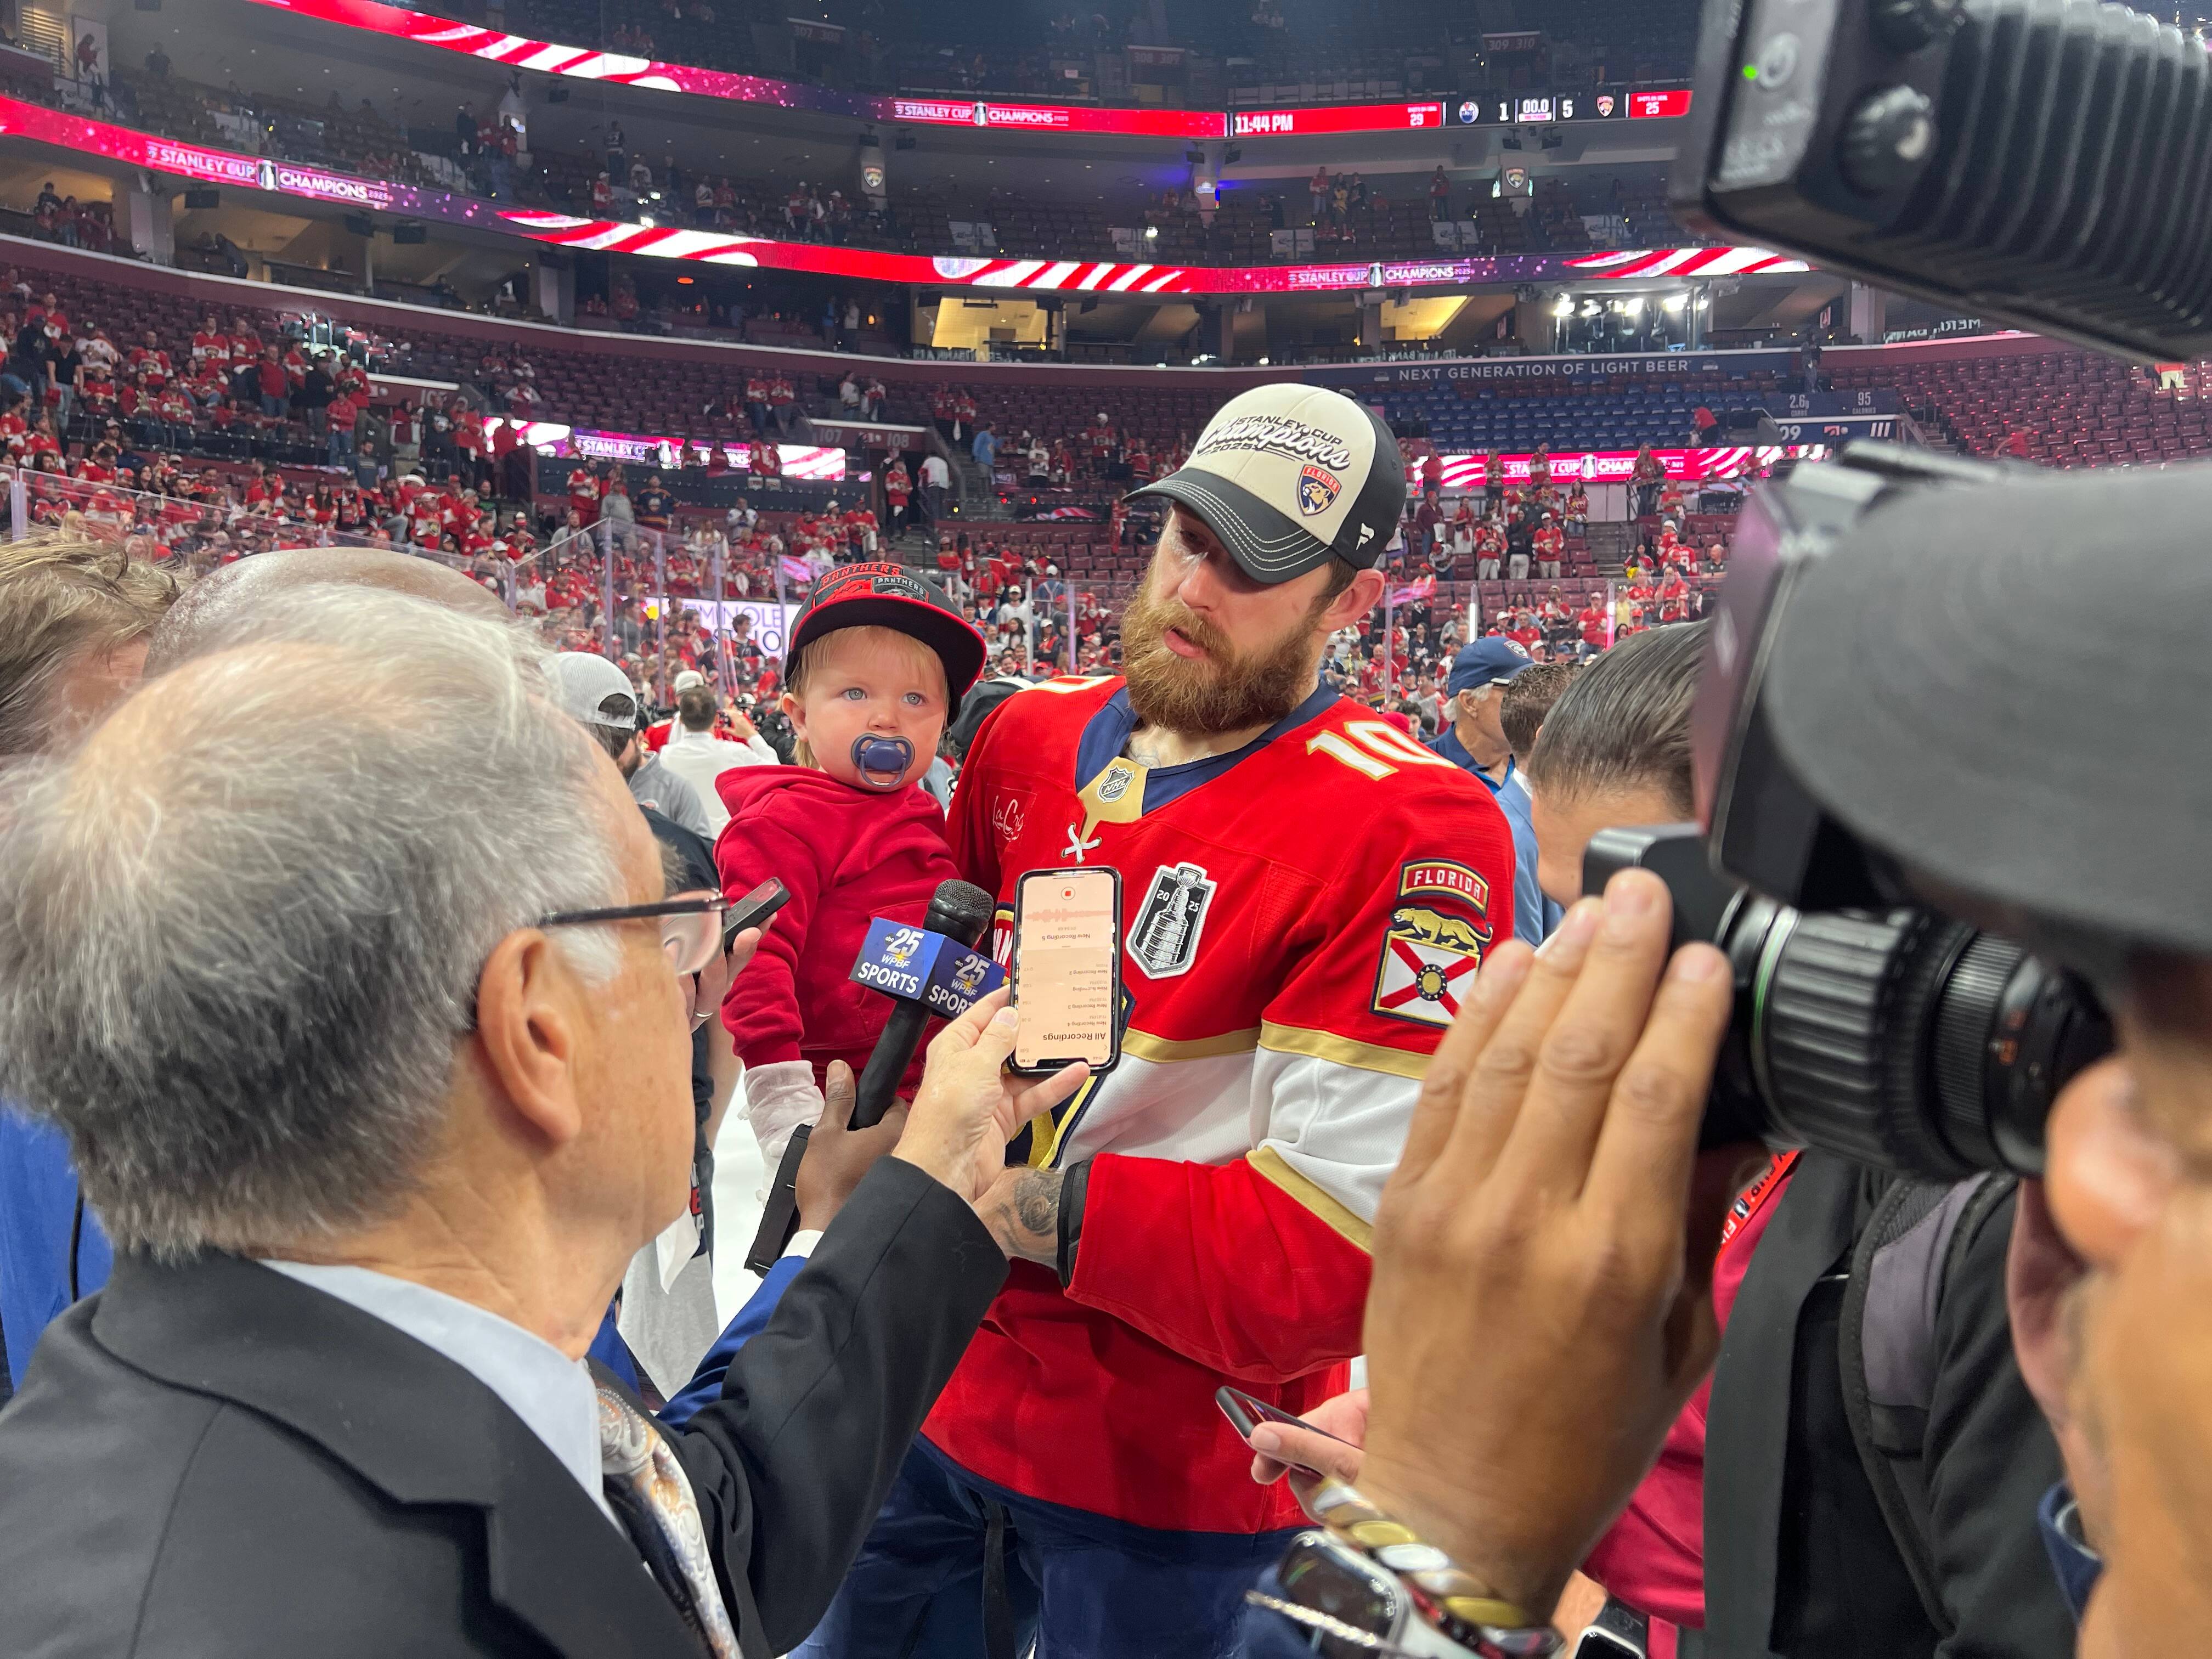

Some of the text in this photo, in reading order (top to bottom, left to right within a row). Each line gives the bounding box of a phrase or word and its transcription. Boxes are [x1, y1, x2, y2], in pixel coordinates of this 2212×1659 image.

[1488, 37, 1535, 50] 309 310
[906, 105, 950, 117] STANLEY
[952, 108, 972, 119] CUP
[989, 110, 1053, 123] CHAMPIONS
[1499, 103, 1509, 121] 1
[1522, 99, 1550, 113] 00.0
[1562, 100, 1573, 118] 5
[1646, 102, 1660, 115] 25
[1235, 114, 1294, 133] 11:44 PM
[1410, 114, 1424, 126] 29
[160, 149, 224, 172] STANLEY
[227, 162, 255, 178] CUP
[279, 172, 368, 199] CHAMPIONS
[1298, 272, 1344, 283] STANLEY
[1344, 270, 1369, 281] CUP
[1385, 267, 1454, 280] CHAMPIONS
[1398, 359, 1689, 381] NEXT GENERATION OF LIGHT BEER
[1858, 391, 1871, 406] 95
[820, 428, 910, 448] 107 108
[1235, 415, 1343, 445] STANLEY CUP
[1780, 425, 1801, 441] 09
[584, 439, 631, 456] STANLEY
[1197, 419, 1350, 470] Champions
[1210, 443, 1255, 454] 2025
[1509, 462, 1581, 475] STAY CUP
[1306, 467, 1339, 491] FLORIDA
[822, 563, 900, 586] PANTHERS
[878, 577, 924, 595] PANTHERS
[1306, 720, 1458, 781] 10
[1105, 778, 1126, 793] NHL
[1413, 870, 1481, 900] FLORIDA
[1156, 889, 1170, 901] 20
[1188, 900, 1200, 912] 25
[886, 928, 925, 957] 25
[881, 954, 911, 968] WPBF
[956, 954, 990, 986] 25
[857, 962, 919, 994] SPORTS
[951, 978, 978, 997] WPBF
[928, 985, 975, 1014] SPOR
[1043, 1033, 1092, 1042] Recordings
